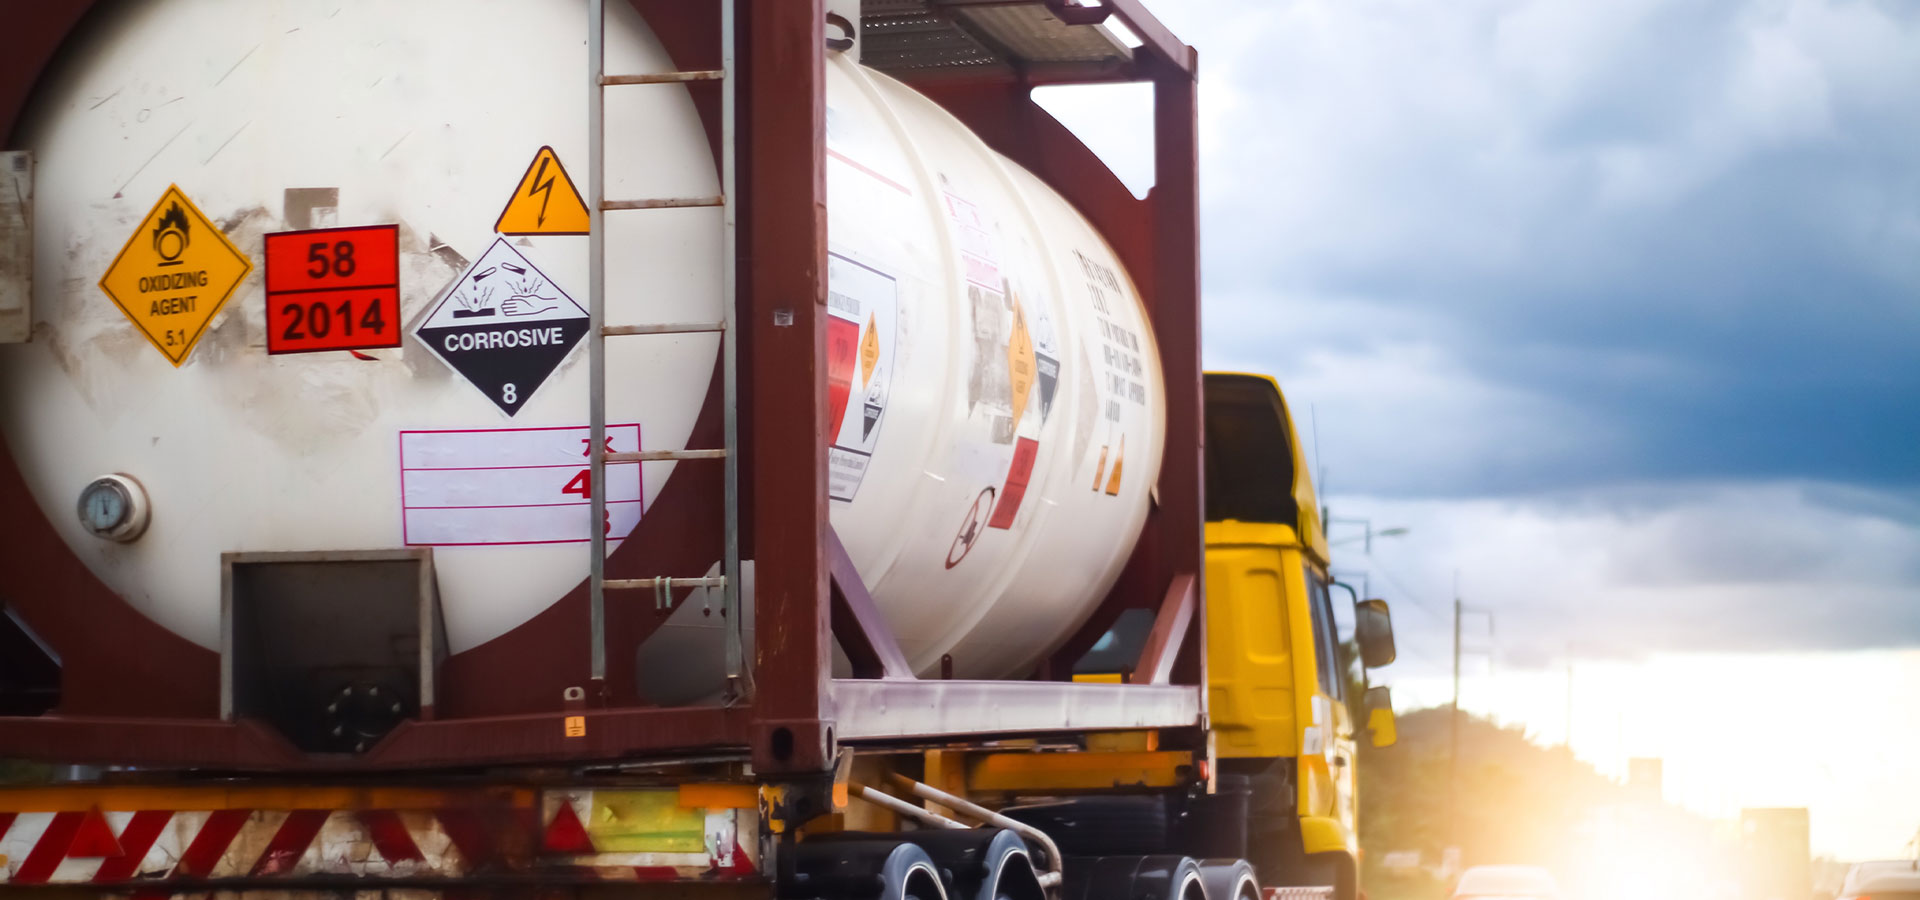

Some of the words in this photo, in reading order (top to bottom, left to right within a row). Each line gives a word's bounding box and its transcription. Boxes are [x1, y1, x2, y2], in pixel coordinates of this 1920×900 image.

[307, 240, 356, 279] 58
[139, 270, 208, 293] OXIDIZING
[150, 295, 198, 316] AGENT
[281, 298, 386, 340] 2014
[166, 329, 186, 347] 5.1
[444, 327, 564, 352] CORROSIVE
[502, 383, 517, 404] 8
